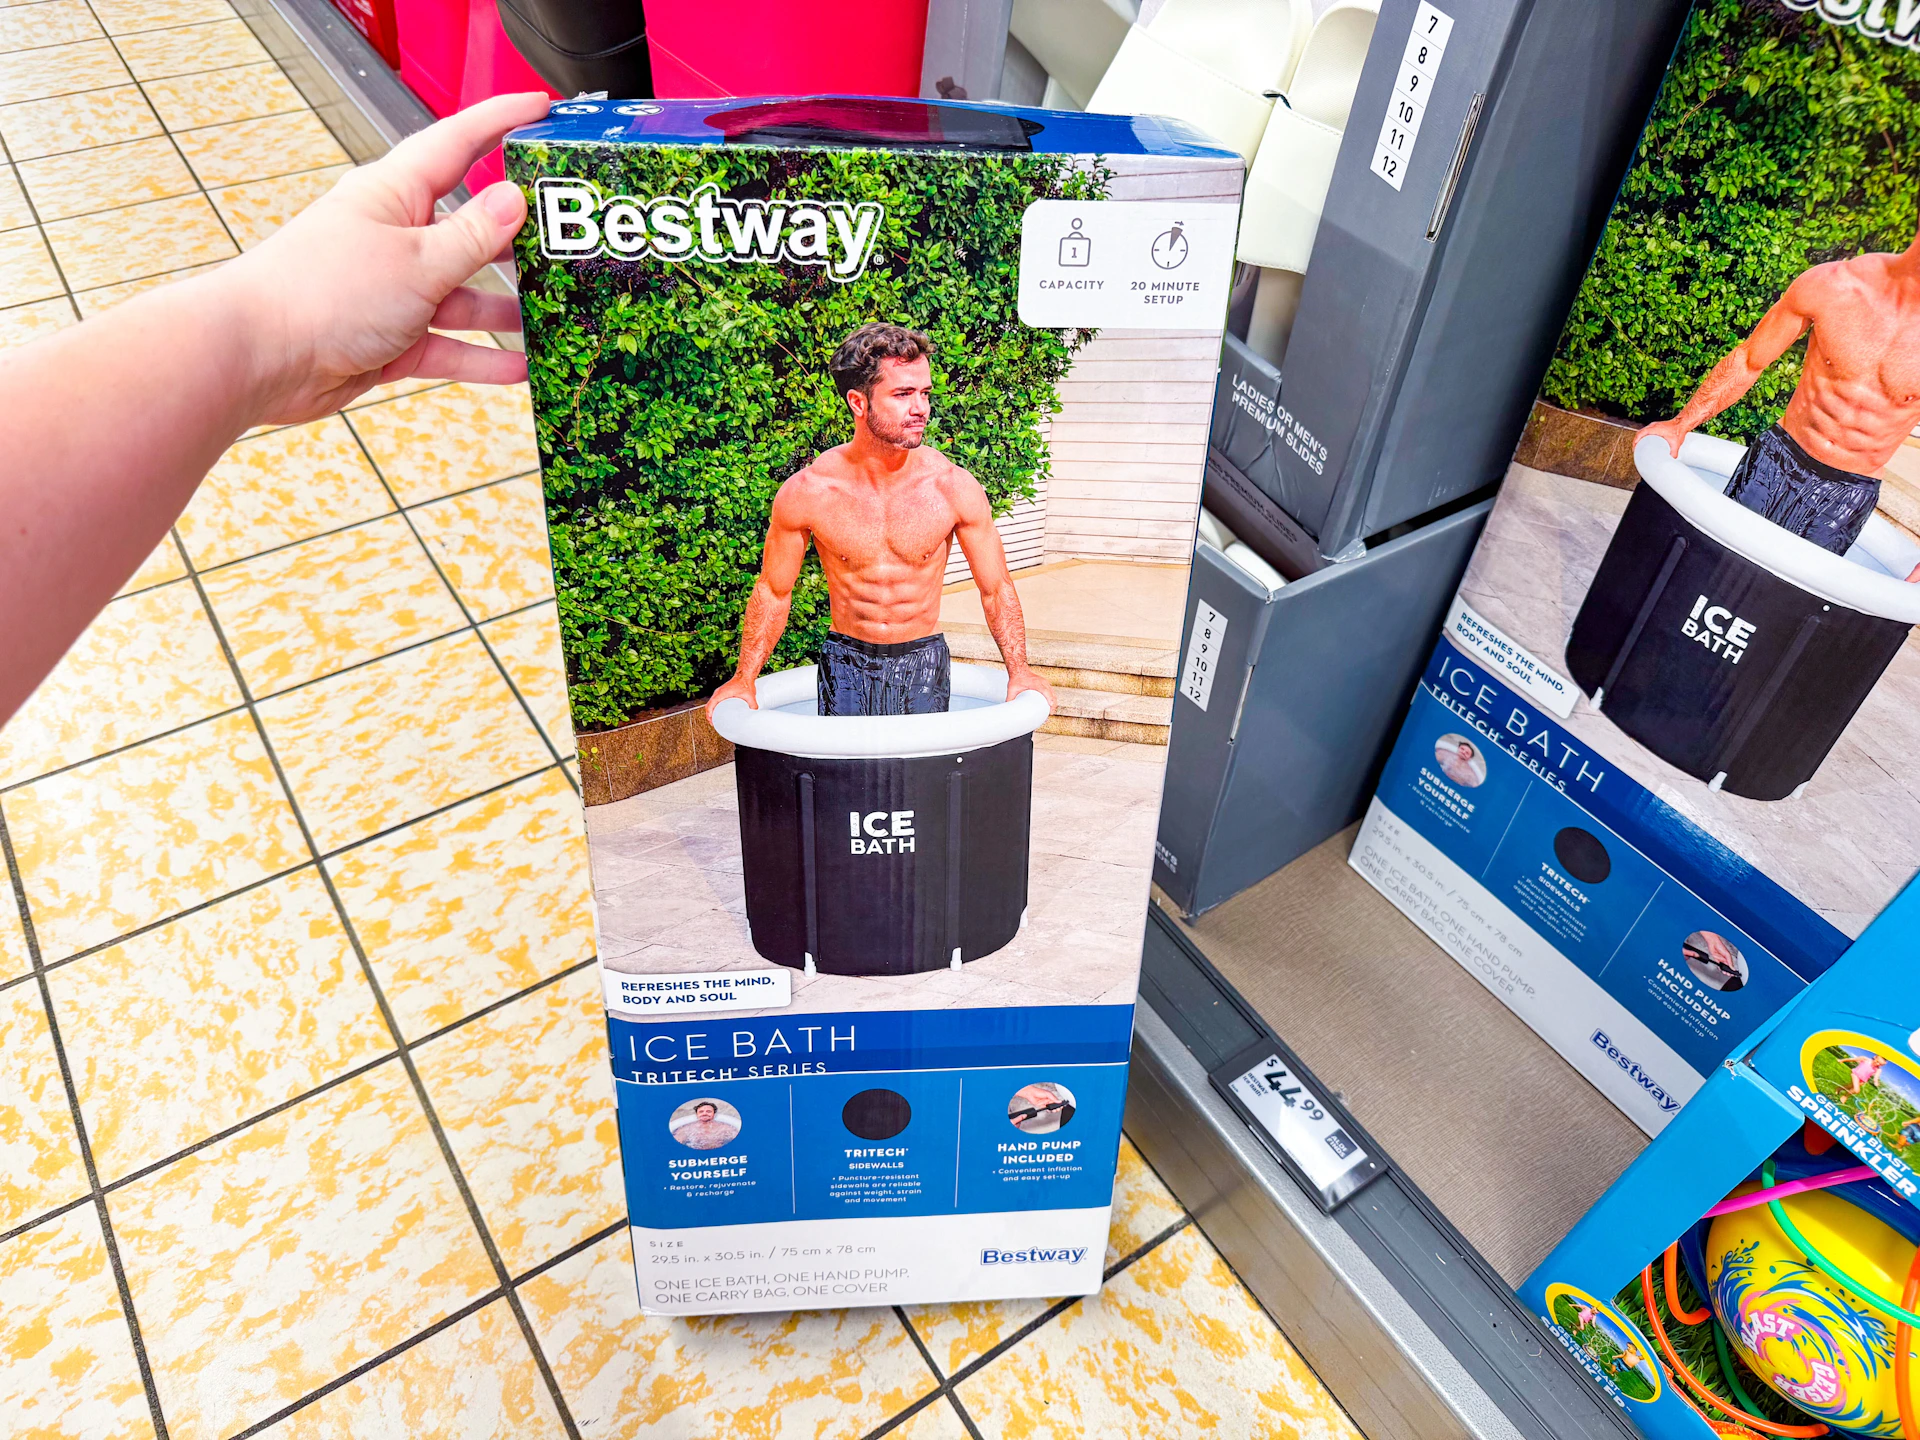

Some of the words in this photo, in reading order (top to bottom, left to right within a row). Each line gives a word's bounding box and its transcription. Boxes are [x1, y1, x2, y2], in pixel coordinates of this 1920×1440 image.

[1428, 15, 1438, 34] 7
[1418, 46, 1428, 64] 8
[1409, 75, 1419, 92] 9
[1398, 101, 1413, 123] 10
[1390, 128, 1405, 150] 11
[1382, 155, 1397, 178] 12
[1038, 279, 1105, 290] CAPACITY
[1130, 281, 1147, 291] 20
[1151, 281, 1200, 292] MINUTE
[1143, 295, 1184, 305] SETUP
[1232, 373, 1275, 415] LADIES
[1276, 405, 1294, 429] OR
[1294, 421, 1328, 462] MEN'S
[1285, 432, 1324, 476] SLIDES
[1208, 611, 1216, 622] 7
[1689, 594, 1757, 650] ICE
[1204, 628, 1212, 640] 8
[1460, 611, 1513, 656] REFRESHES
[1515, 652, 1535, 671] THE
[1680, 617, 1744, 665] BATH
[1201, 643, 1208, 654] 9
[1456, 623, 1483, 647] BODY
[1483, 645, 1505, 664] AND
[1506, 662, 1532, 685] SOUL
[1195, 656, 1207, 672] 10
[1192, 671, 1204, 687] 11
[1189, 686, 1201, 702] 12
[1438, 656, 1498, 715] ICE
[1505, 708, 1604, 793] BATH
[1508, 743, 1567, 793] SERIES
[1418, 777, 1470, 820] YOURSELF
[1420, 767, 1475, 813] SUBMERGE
[849, 810, 915, 838] ICE
[850, 837, 916, 855] BATH
[1538, 875, 1581, 913] SIDEWALLS
[1364, 845, 1388, 870] ONE
[1389, 866, 1409, 887] ICE
[1440, 910, 1467, 937] ONE
[1467, 932, 1501, 967] HAND
[1360, 855, 1384, 880] ONE
[1384, 876, 1421, 912] CARRY
[1446, 931, 1473, 958] ONE
[1473, 955, 1515, 996] COVER
[621, 980, 700, 992] REFRESHES
[703, 979, 731, 989] THE
[734, 976, 775, 987] MIND,
[1657, 958, 1694, 989] HAND
[1694, 989, 1731, 1020] PUMP
[622, 994, 662, 1005] BODY
[666, 994, 696, 1004] AND
[699, 992, 737, 1003] SOUL
[1656, 972, 1718, 1026] INCLUDED
[1647, 978, 1688, 1014] Convenient
[1688, 1013, 1719, 1041] inflation
[1648, 988, 1662, 1001] and
[1662, 1000, 1680, 1016] easy
[1681, 1015, 1705, 1038] set-up
[629, 1033, 710, 1063] ICE
[732, 1025, 856, 1059] BATH
[748, 1062, 827, 1079] SERIES
[1331, 1135, 1348, 1152] ALDI
[1786, 1084, 1918, 1197] SPRINKLER
[1815, 1093, 1867, 1139] GEYSER
[1867, 1133, 1911, 1174] BLAST
[997, 1142, 1038, 1152] HAND
[1041, 1140, 1082, 1150] PUMP
[1327, 1137, 1347, 1158] FINDS
[668, 1155, 748, 1169] SUBMERGE
[848, 1161, 904, 1170] SIDEWALLS
[1002, 1153, 1074, 1165] INCLUDED
[670, 1168, 747, 1181] YOURSELF
[709, 1180, 757, 1189] rejuvenate
[838, 1173, 919, 1181] Puncture-resistant
[1043, 1173, 1071, 1181] set-up
[829, 1190, 861, 1198] against
[649, 1240, 684, 1248] SIZE
[651, 1254, 680, 1264] 29.5
[684, 1253, 700, 1263] in.
[715, 1250, 746, 1261] 30.5
[749, 1250, 765, 1259] in.
[768, 1246, 776, 1259] /
[781, 1247, 798, 1257] 75
[802, 1248, 821, 1256] cm
[836, 1245, 853, 1254] 78
[857, 1245, 876, 1254] cm
[654, 1279, 691, 1291] ONE
[695, 1277, 723, 1289] ICE
[774, 1271, 810, 1284] ONE
[814, 1269, 861, 1281] HAND
[655, 1293, 692, 1304] ONE
[695, 1289, 749, 1302] CARRY
[793, 1284, 829, 1297] ONE
[832, 1282, 889, 1294] COVER
[1740, 1312, 1795, 1356] BLAST
[1557, 1325, 1591, 1361] GEYSER
[1591, 1362, 1620, 1392] BLAST
[1773, 1361, 1837, 1403] GEYSER
